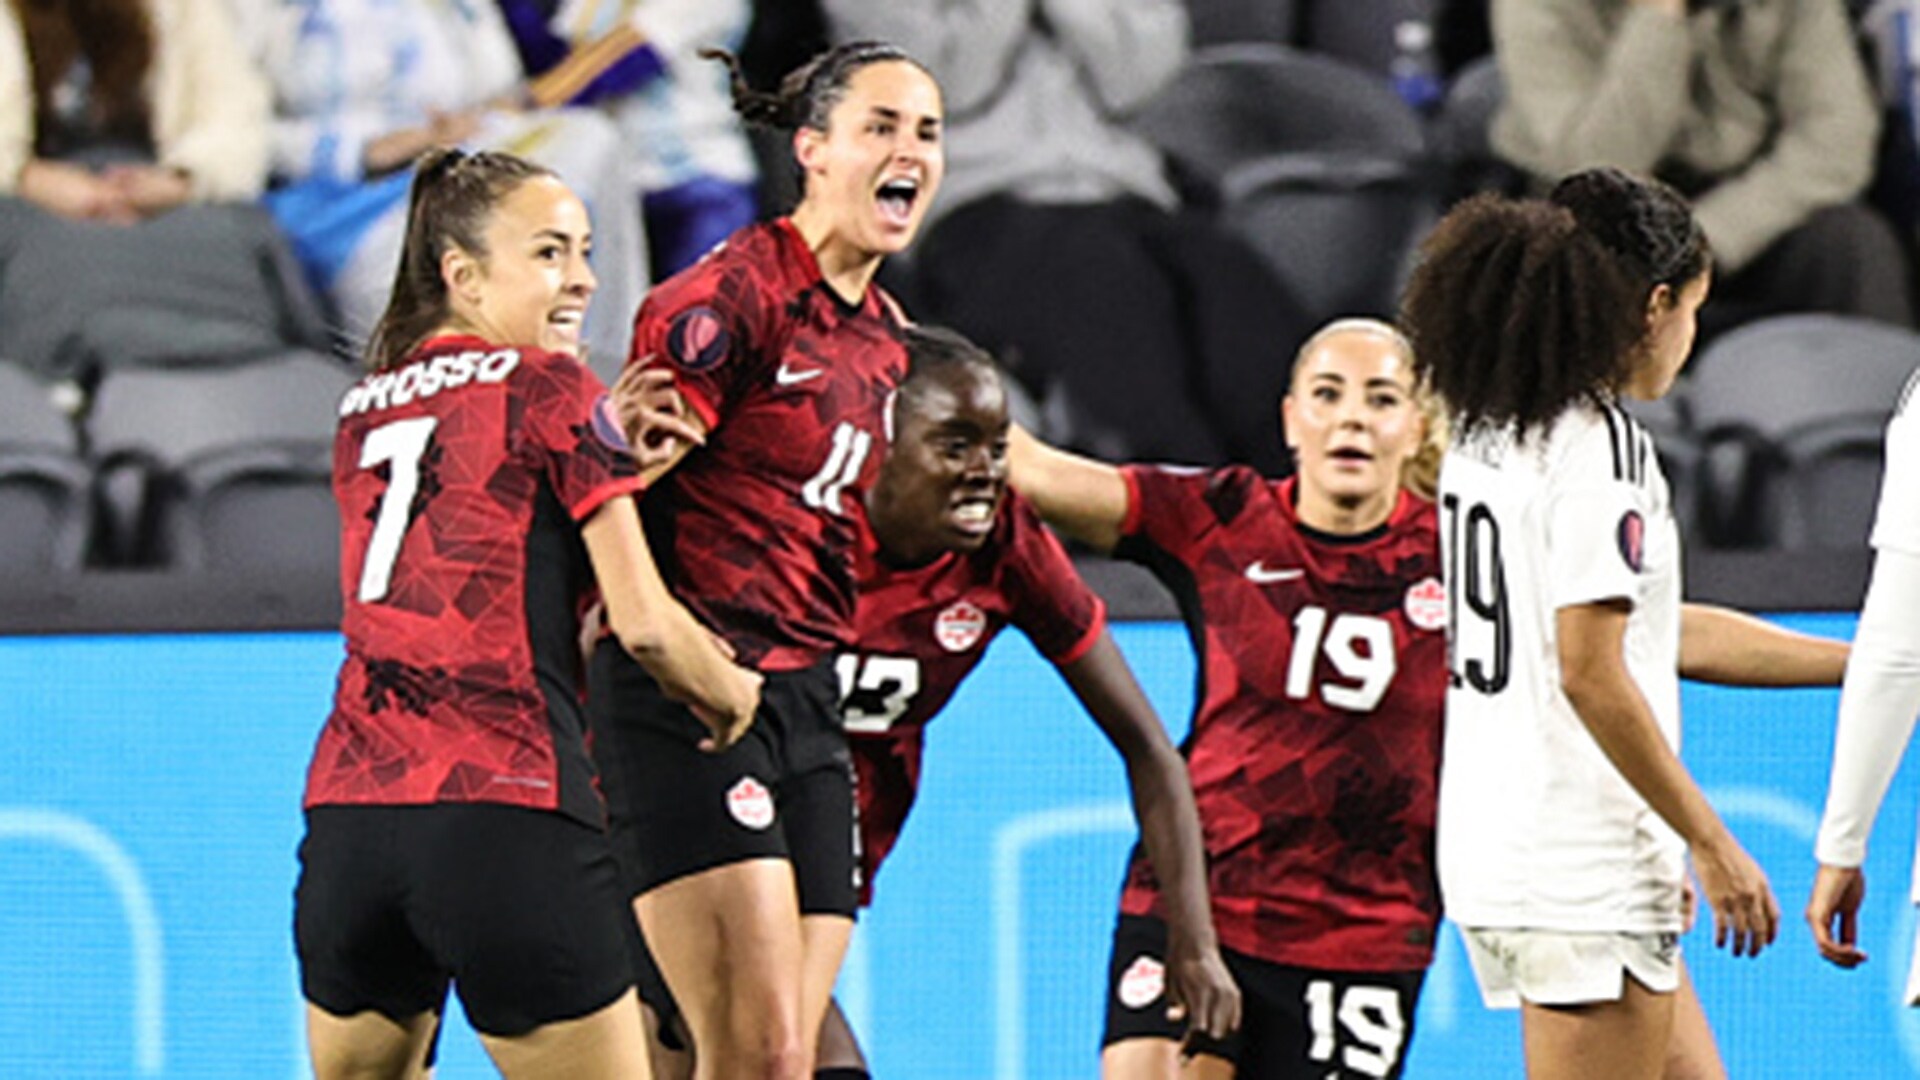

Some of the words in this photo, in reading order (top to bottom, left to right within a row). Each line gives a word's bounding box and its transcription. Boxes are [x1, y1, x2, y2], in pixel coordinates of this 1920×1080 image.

[358, 415, 438, 603] 7
[801, 420, 871, 516] 11
[1443, 492, 1512, 697] 19
[835, 653, 919, 732] 13
[1285, 604, 1397, 712] 19
[1304, 979, 1405, 1078] 19
